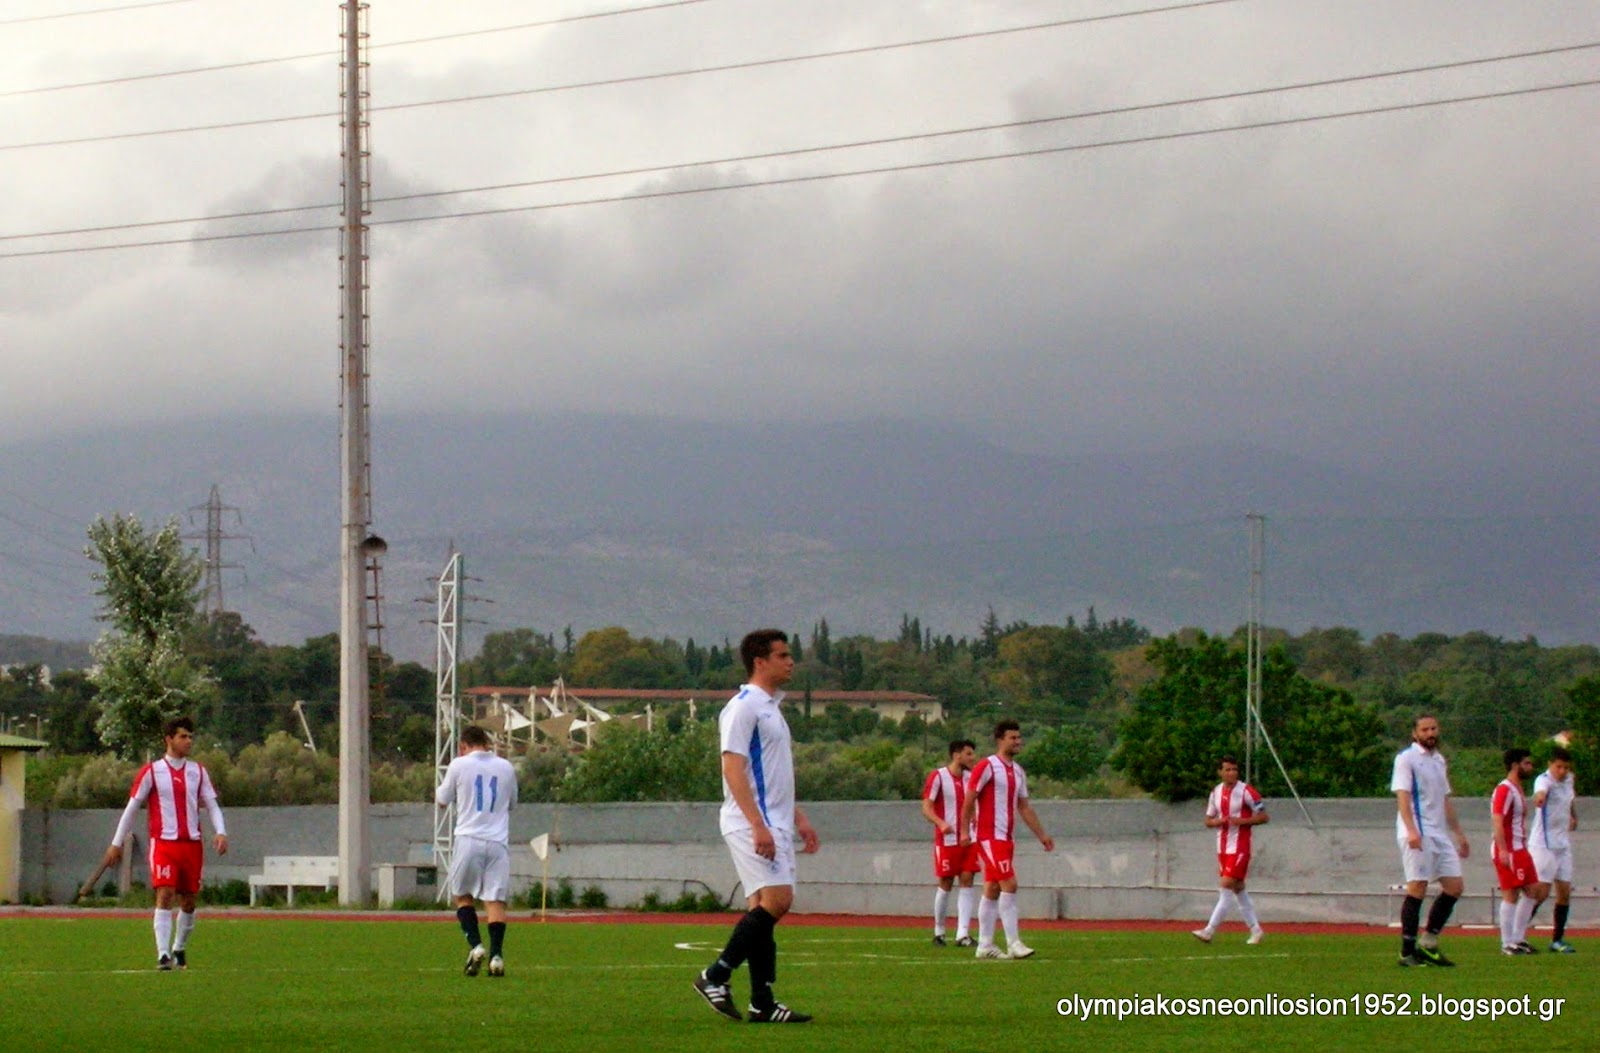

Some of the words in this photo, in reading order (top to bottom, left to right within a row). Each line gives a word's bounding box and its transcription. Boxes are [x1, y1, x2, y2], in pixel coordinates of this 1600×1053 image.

[475, 774, 498, 813] 11
[156, 864, 171, 880] 14
[942, 859, 950, 872] 5
[998, 860, 1010, 874] 17
